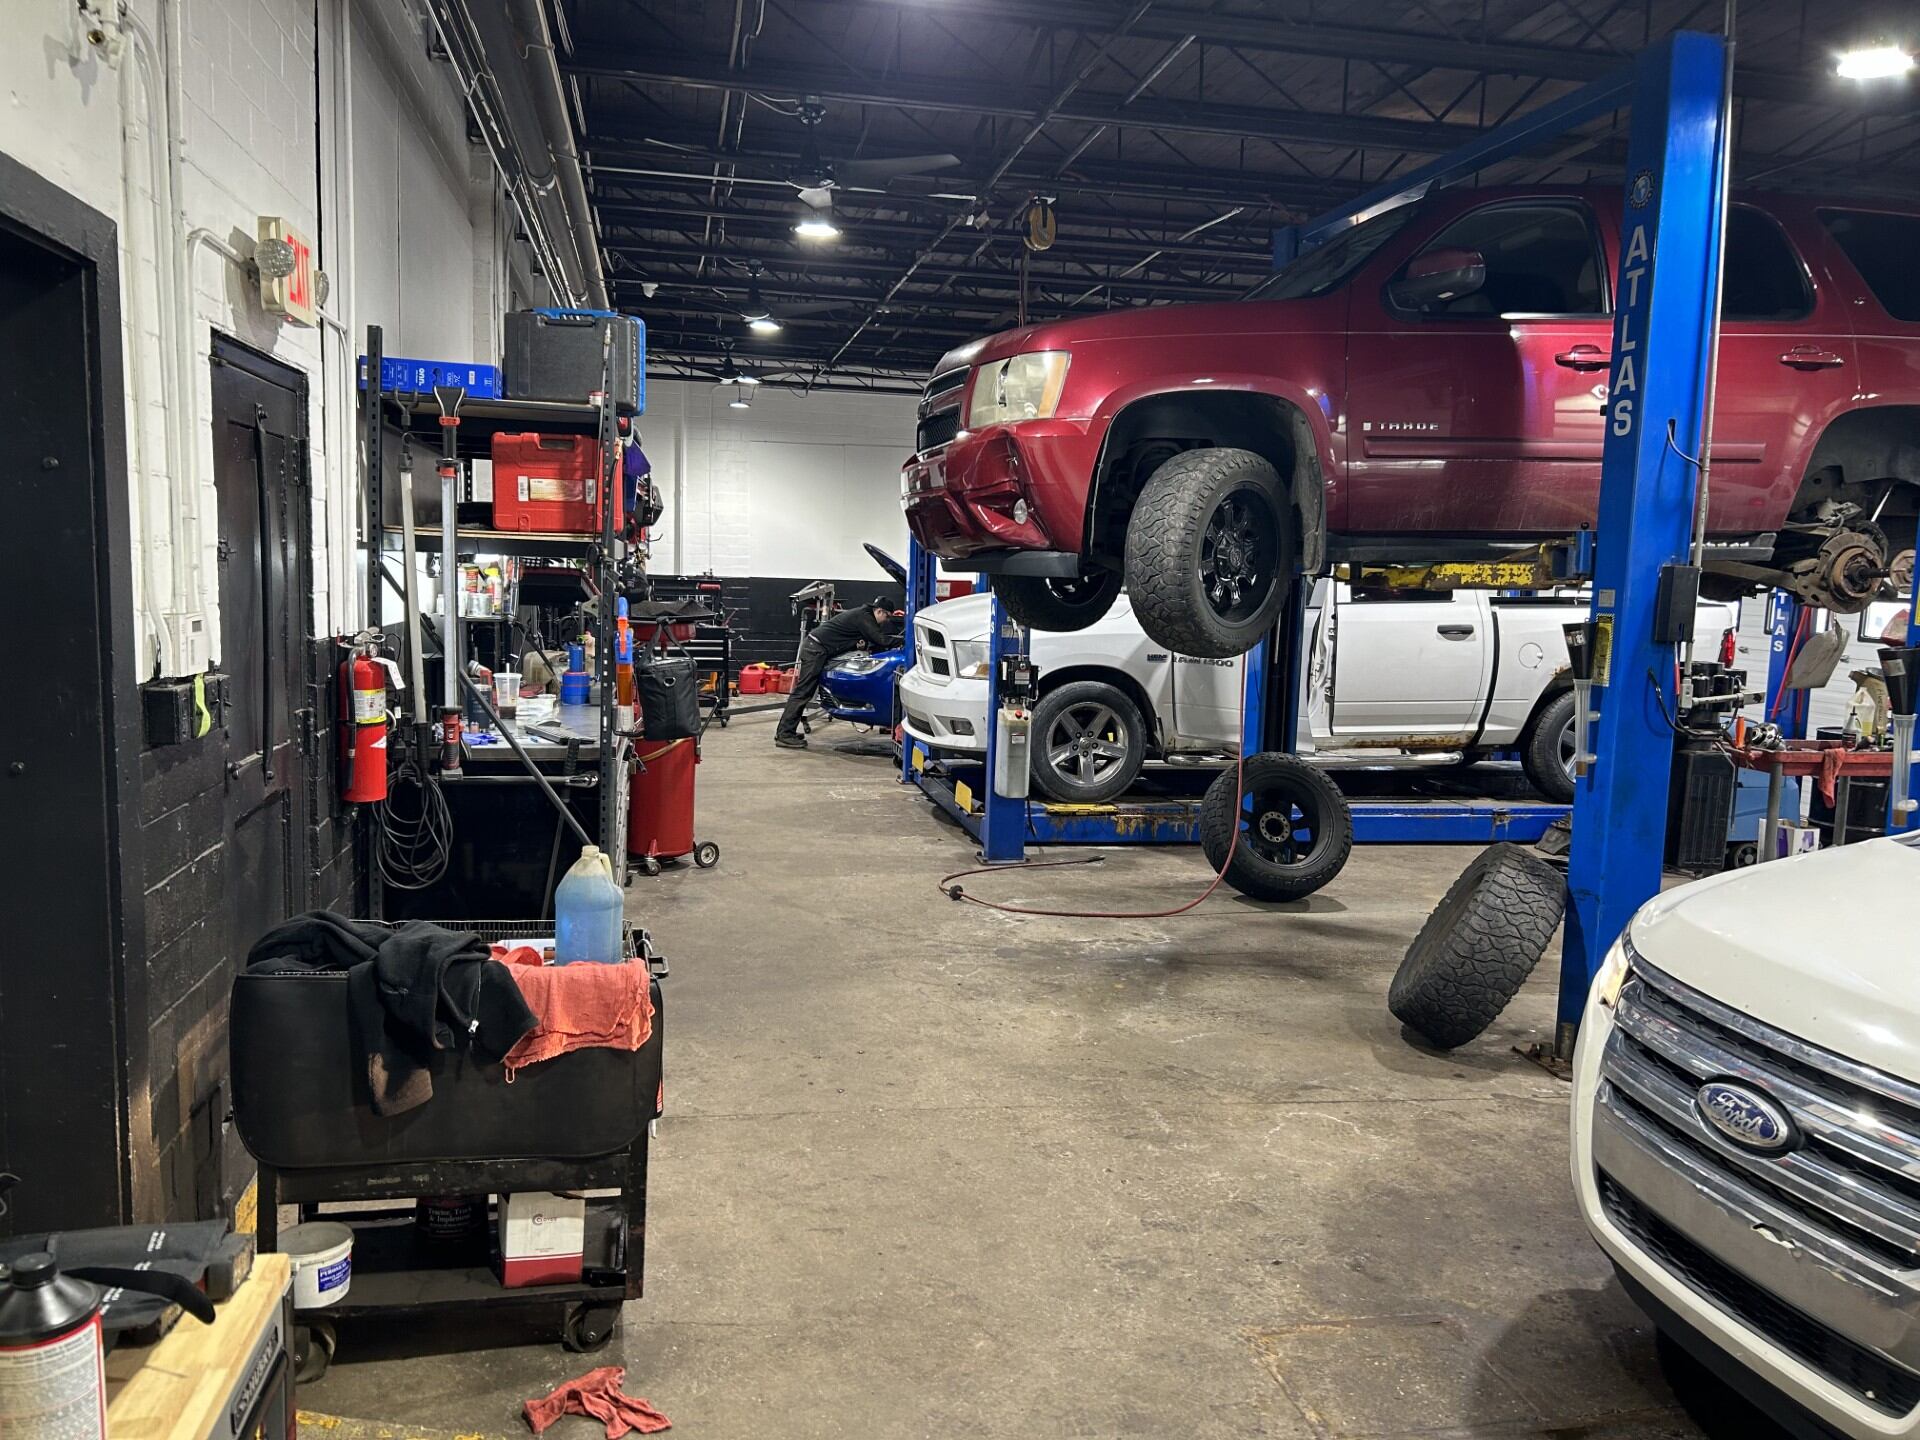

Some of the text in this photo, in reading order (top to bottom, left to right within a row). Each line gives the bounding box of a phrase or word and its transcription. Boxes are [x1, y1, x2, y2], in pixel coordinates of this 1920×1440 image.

[1613, 225, 1649, 437] ATLAS
[1379, 422, 1439, 431] TAHOE
[1203, 659, 1233, 667] 1500
[1711, 1092, 1763, 1136] Ford
